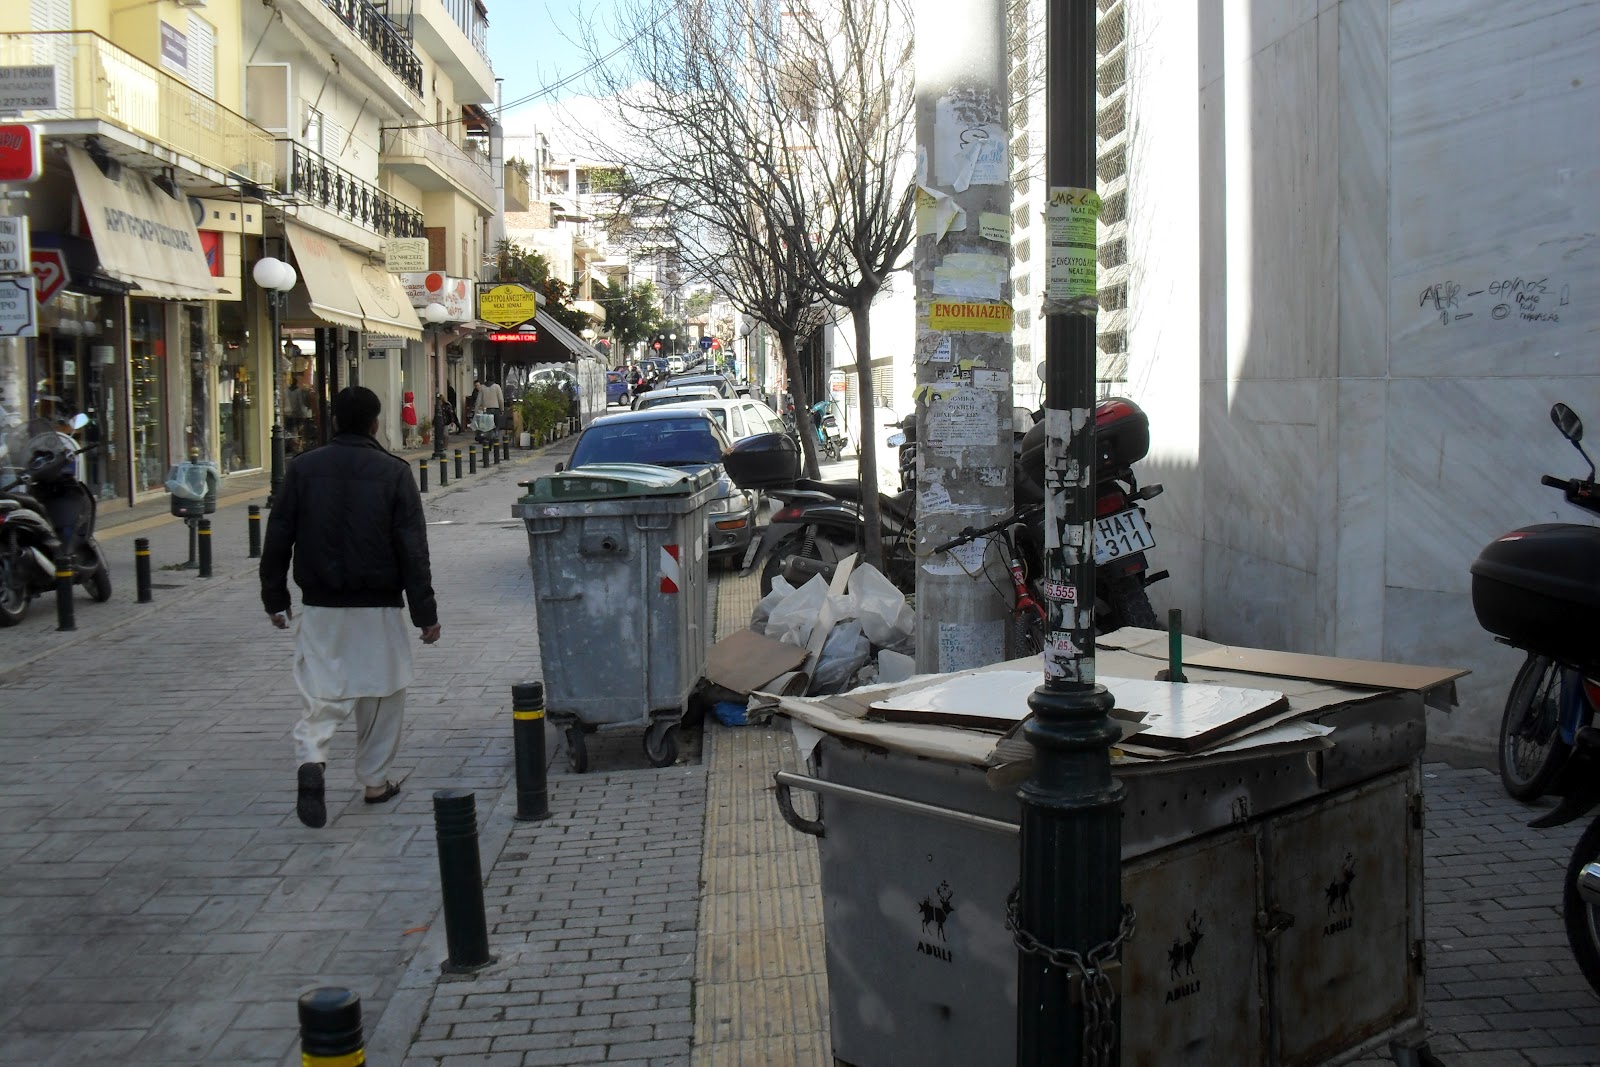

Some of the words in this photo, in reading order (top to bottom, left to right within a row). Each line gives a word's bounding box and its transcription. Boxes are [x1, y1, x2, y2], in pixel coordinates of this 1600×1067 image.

[30, 97, 49, 106] 326
[1068, 267, 1083, 275] ΝΕΑΣ
[1098, 511, 1135, 540] HAT
[1105, 530, 1146, 557] 311
